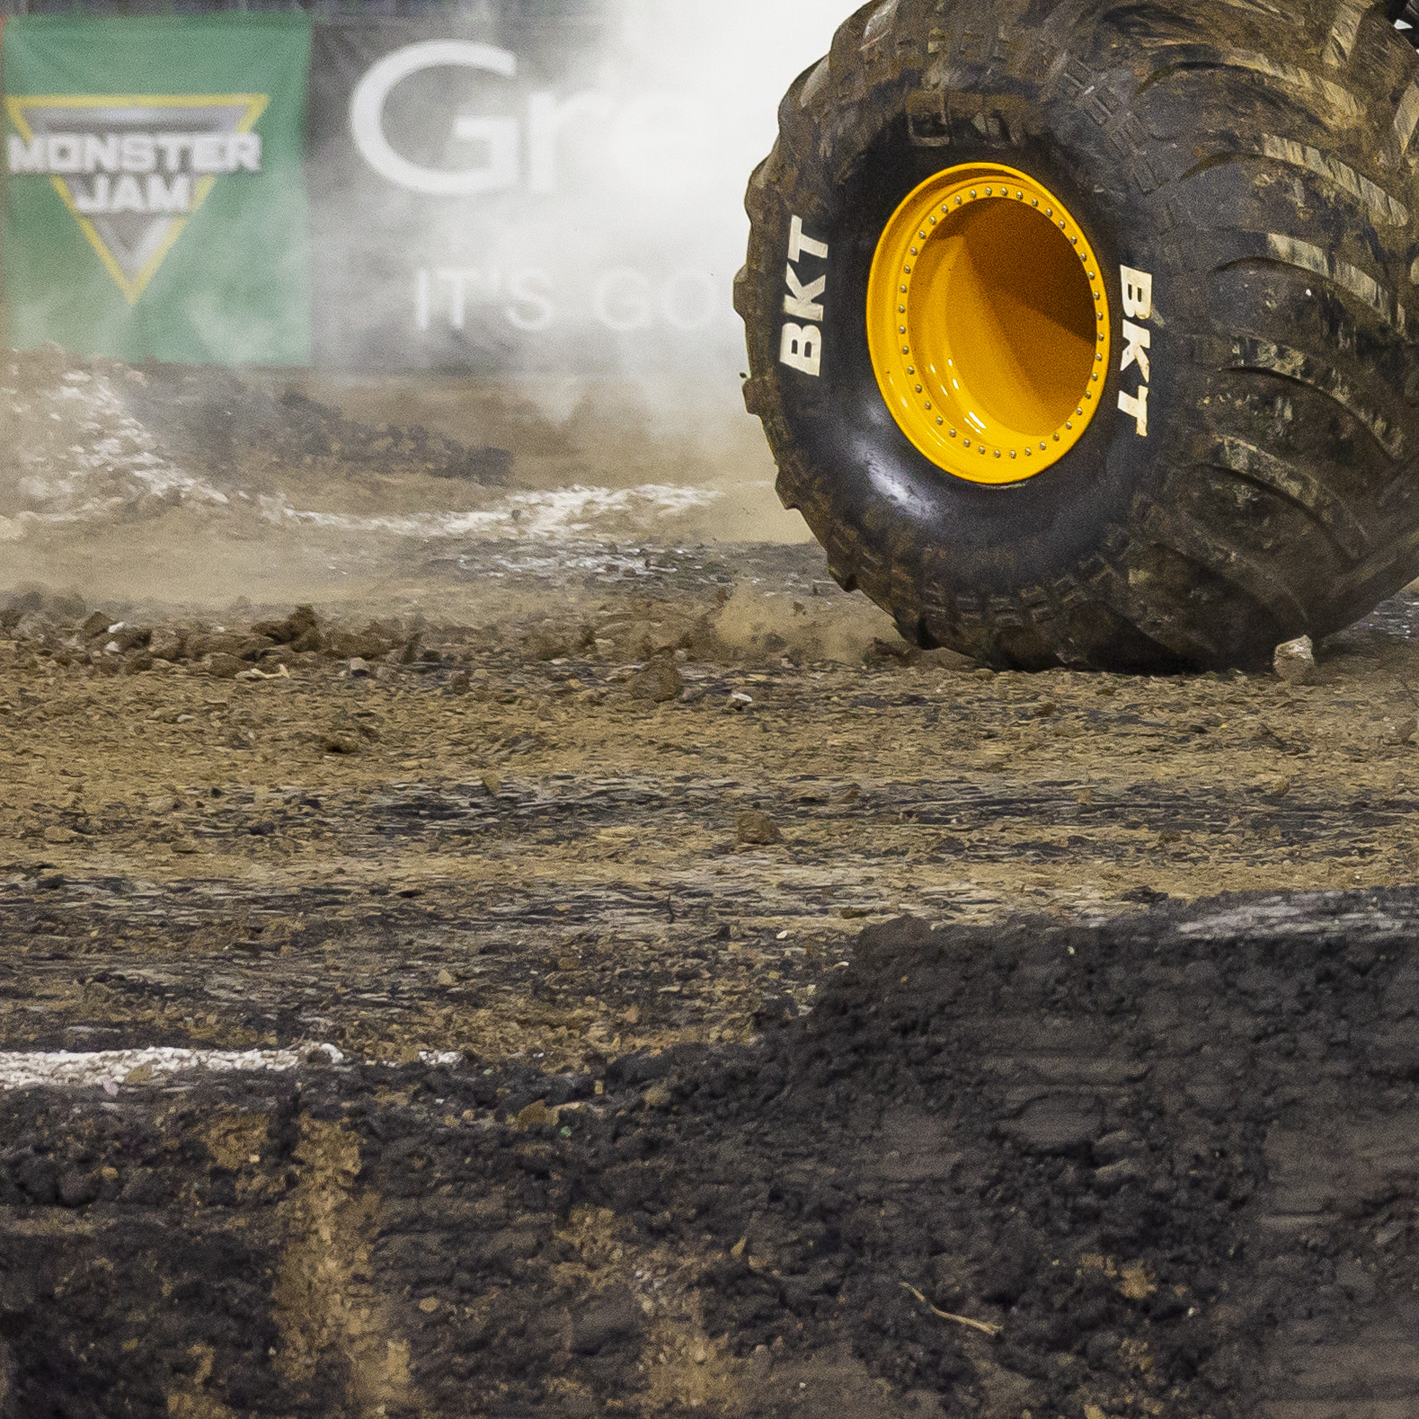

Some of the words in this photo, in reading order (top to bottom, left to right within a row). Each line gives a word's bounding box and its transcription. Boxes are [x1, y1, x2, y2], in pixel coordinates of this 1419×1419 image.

[7, 132, 262, 175] MONSTER
[75, 175, 192, 213] JAM
[780, 214, 829, 377] BKT
[1117, 264, 1153, 437] BKT
